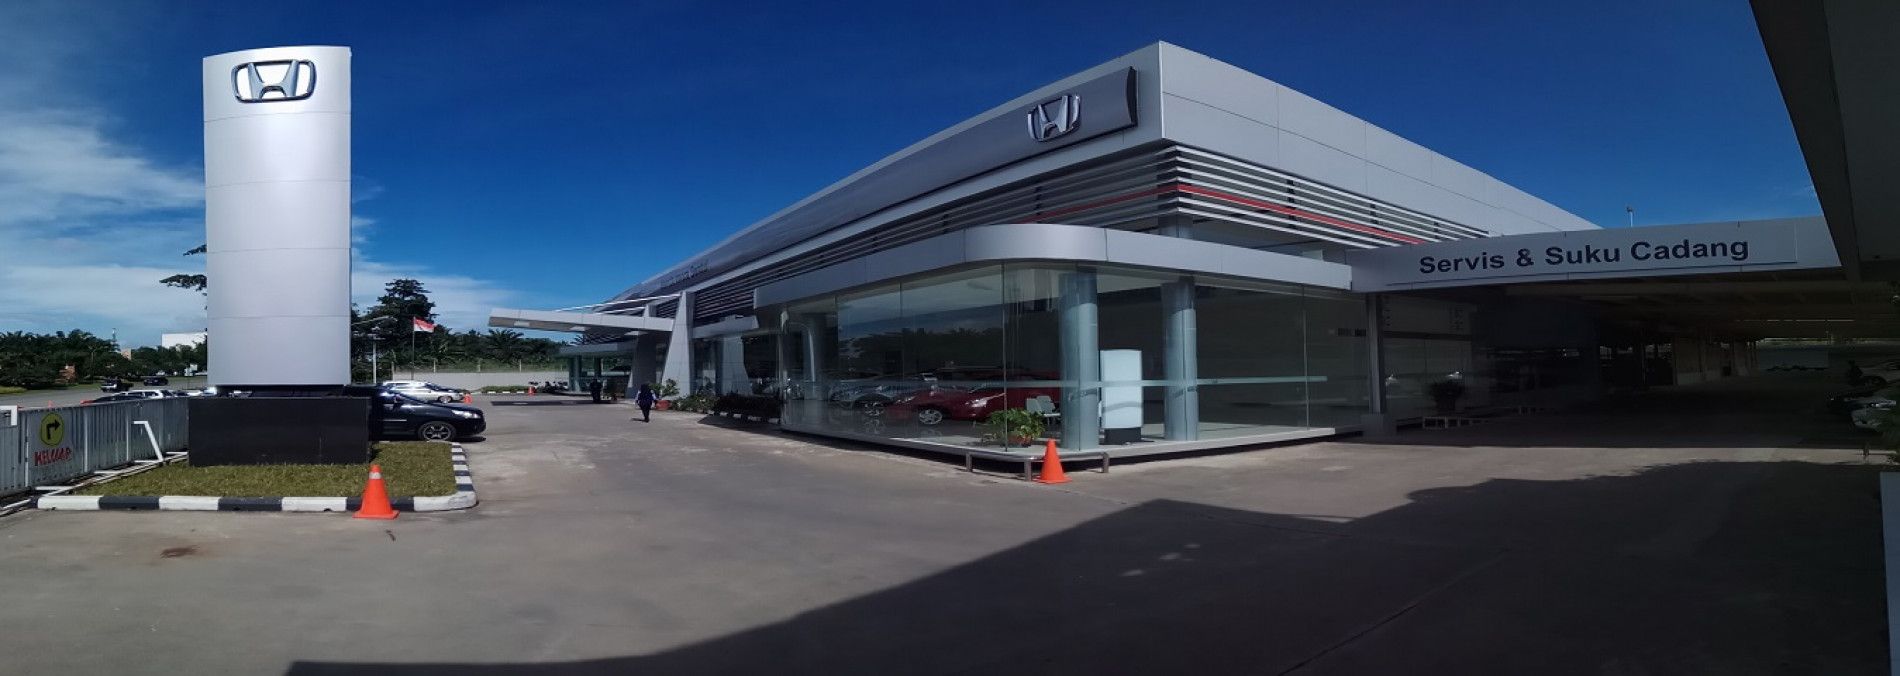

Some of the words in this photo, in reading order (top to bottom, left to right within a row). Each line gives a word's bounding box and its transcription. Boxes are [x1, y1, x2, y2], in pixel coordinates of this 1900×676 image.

[1419, 251, 1505, 274] Servis
[1516, 248, 1535, 267] &
[1545, 244, 1621, 266] Suku
[1630, 238, 1749, 262] Cadang
